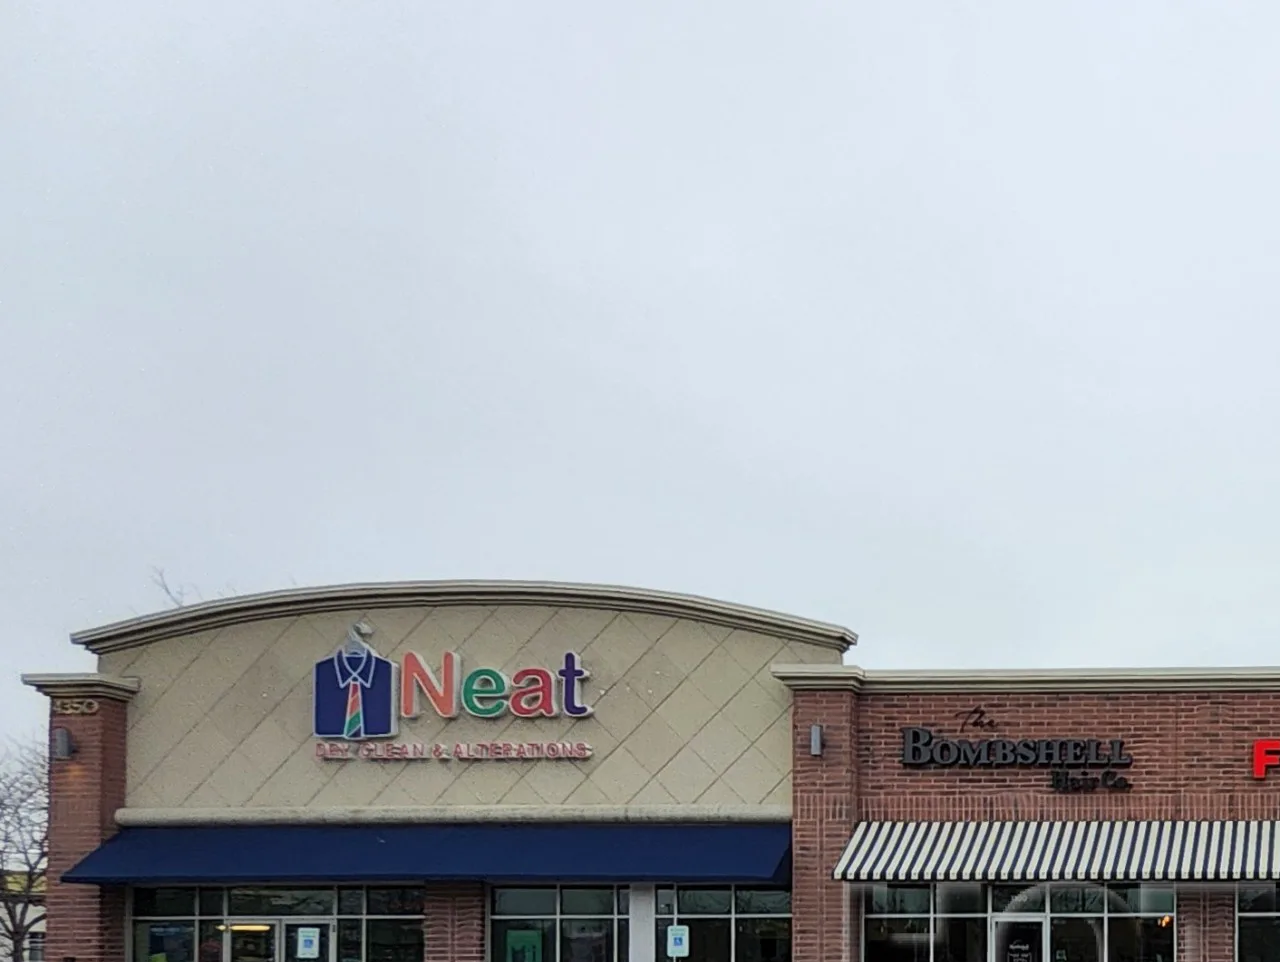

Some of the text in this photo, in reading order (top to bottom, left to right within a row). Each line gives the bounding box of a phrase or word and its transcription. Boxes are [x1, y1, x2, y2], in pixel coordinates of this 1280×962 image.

[401, 650, 594, 718] Neat
[954, 705, 998, 733] The
[360, 742, 426, 759] CLEAN
[432, 742, 449, 759] &
[452, 742, 593, 759] ALTERATIONS
[901, 726, 1134, 767] BOMBSHELL
